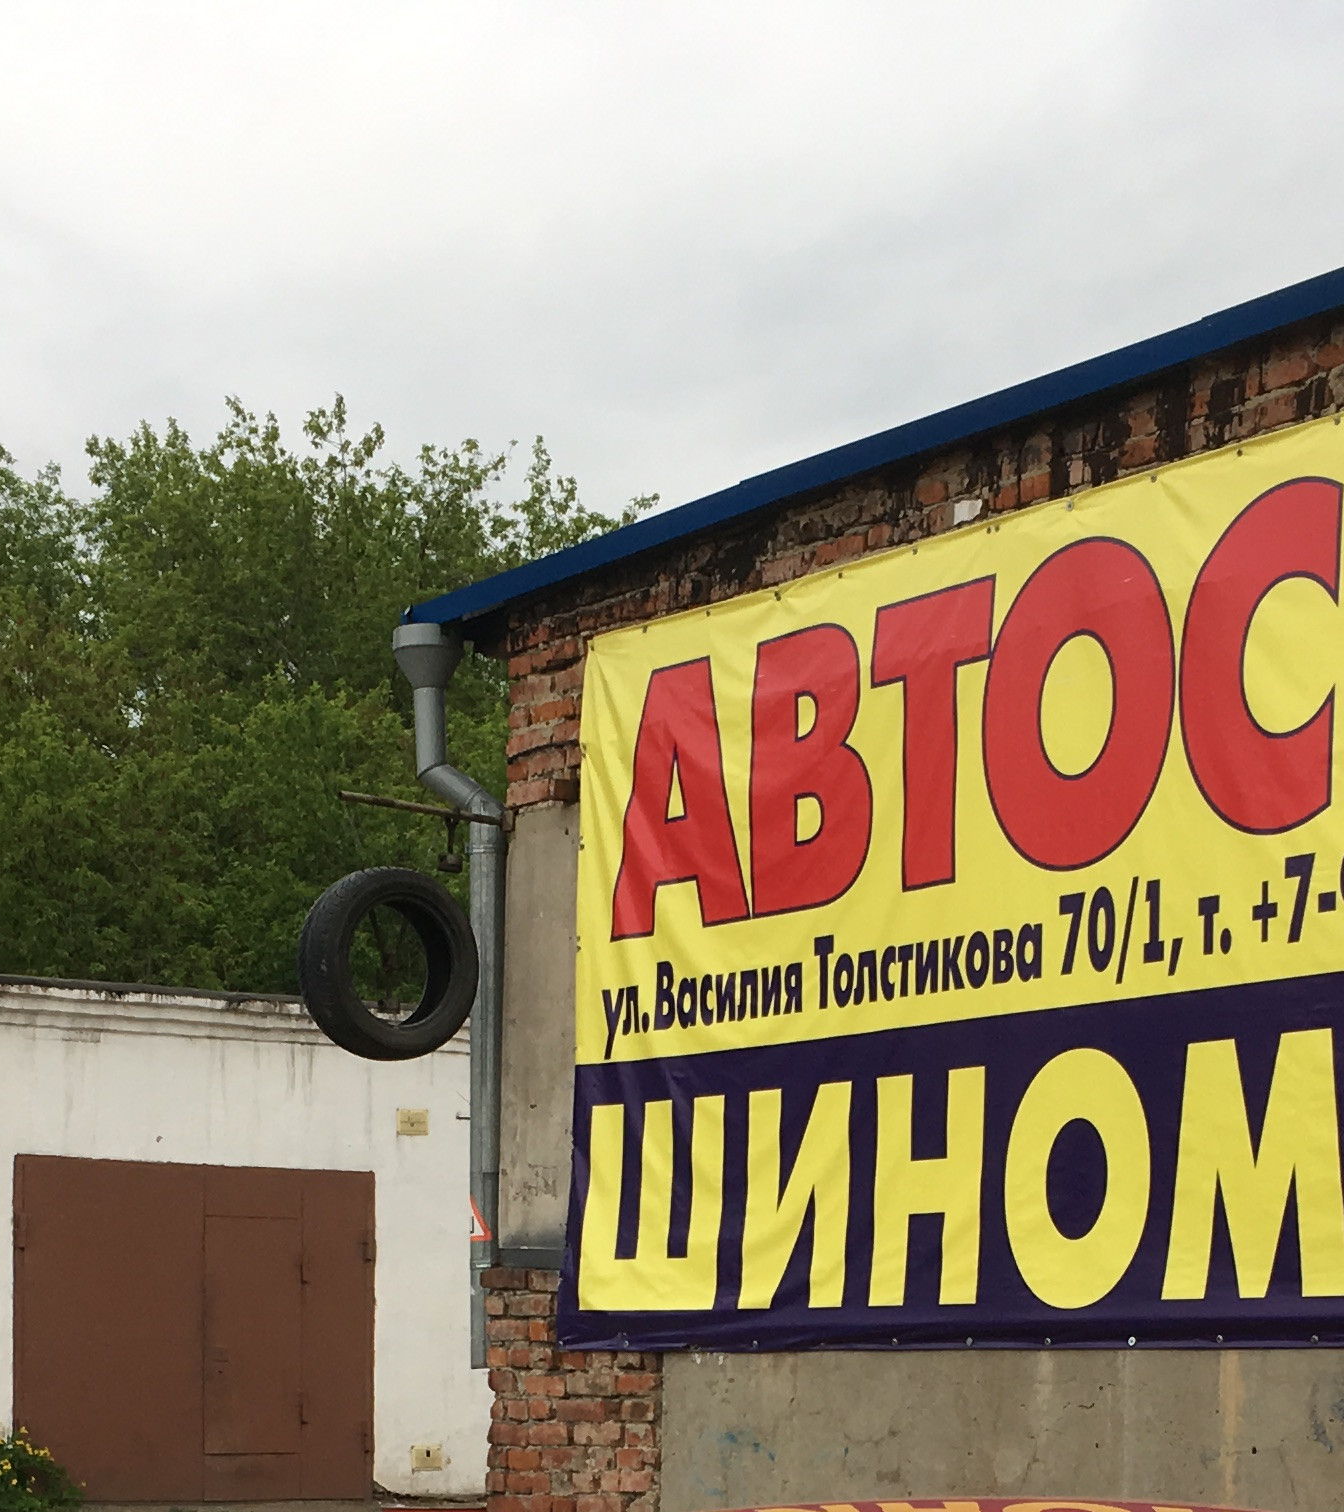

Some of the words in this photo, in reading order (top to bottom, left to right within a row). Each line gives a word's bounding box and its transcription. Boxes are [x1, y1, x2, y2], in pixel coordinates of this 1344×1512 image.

[813, 921, 1044, 1007] Толстикова
[1058, 876, 1183, 984] 70/1,
[1198, 894, 1233, 957] т.
